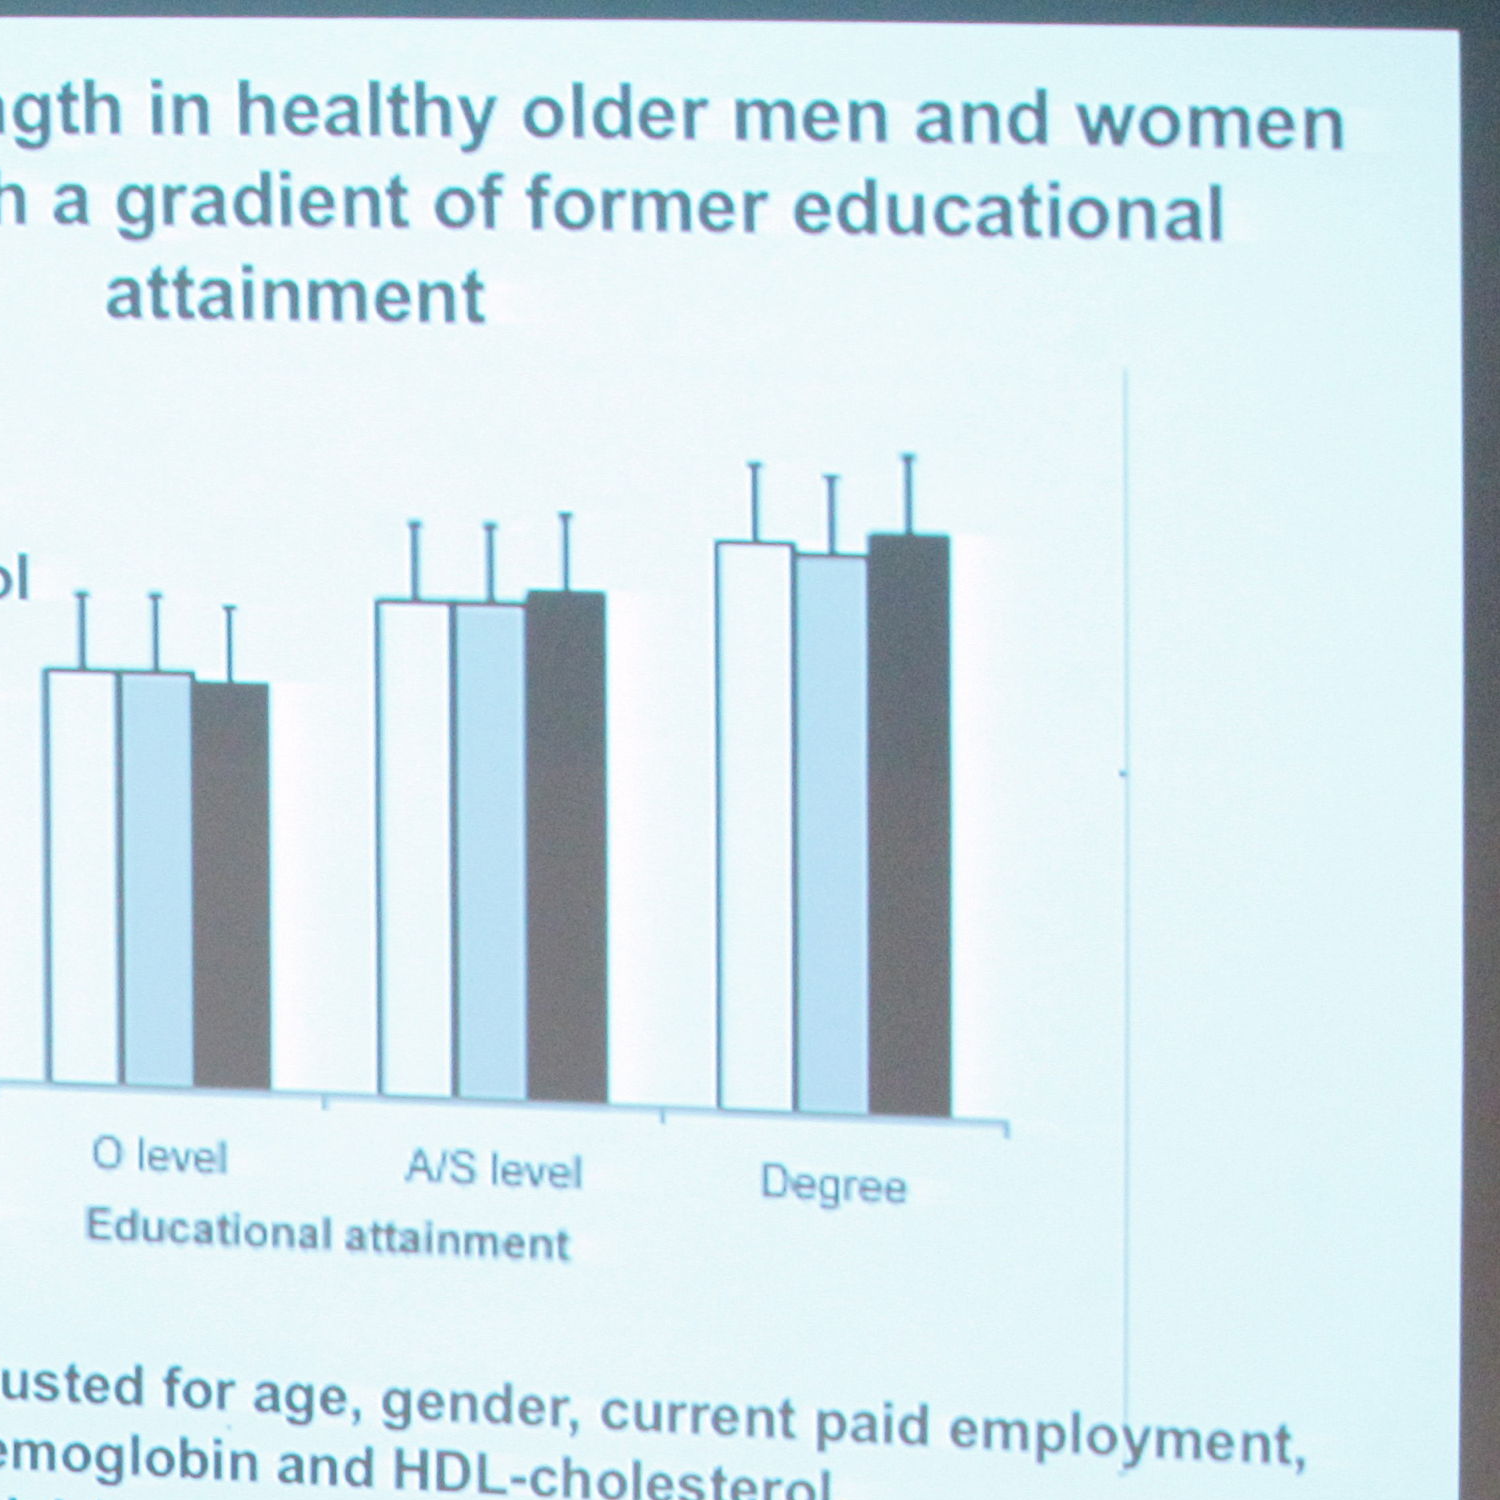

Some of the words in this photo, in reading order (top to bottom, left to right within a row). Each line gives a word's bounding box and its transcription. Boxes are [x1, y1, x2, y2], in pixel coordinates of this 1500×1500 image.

[150, 77, 210, 135] in
[238, 78, 498, 153] healthy
[523, 80, 710, 140] older
[735, 97, 888, 142] men
[916, 86, 1049, 144] and
[1076, 103, 1345, 150] women
[53, 182, 90, 225] a
[116, 169, 410, 241] gradient
[434, 170, 506, 229] of
[525, 171, 770, 233] former
[793, 176, 1223, 241] educational
[106, 263, 486, 324] attainment
[92, 1133, 125, 1170] O
[138, 1135, 228, 1174] level
[404, 1146, 478, 1186] A/S
[491, 1150, 583, 1190] level
[761, 1161, 909, 1211] Degree
[85, 1205, 333, 1250] Educational
[345, 1219, 571, 1263] attainment
[162, 1364, 237, 1411] for
[253, 1380, 362, 1426] age,
[381, 1381, 580, 1437] gender,
[601, 1397, 797, 1440] current
[817, 1399, 930, 1453] paid
[950, 1409, 1307, 1475] employment,
[277, 1444, 375, 1488] and
